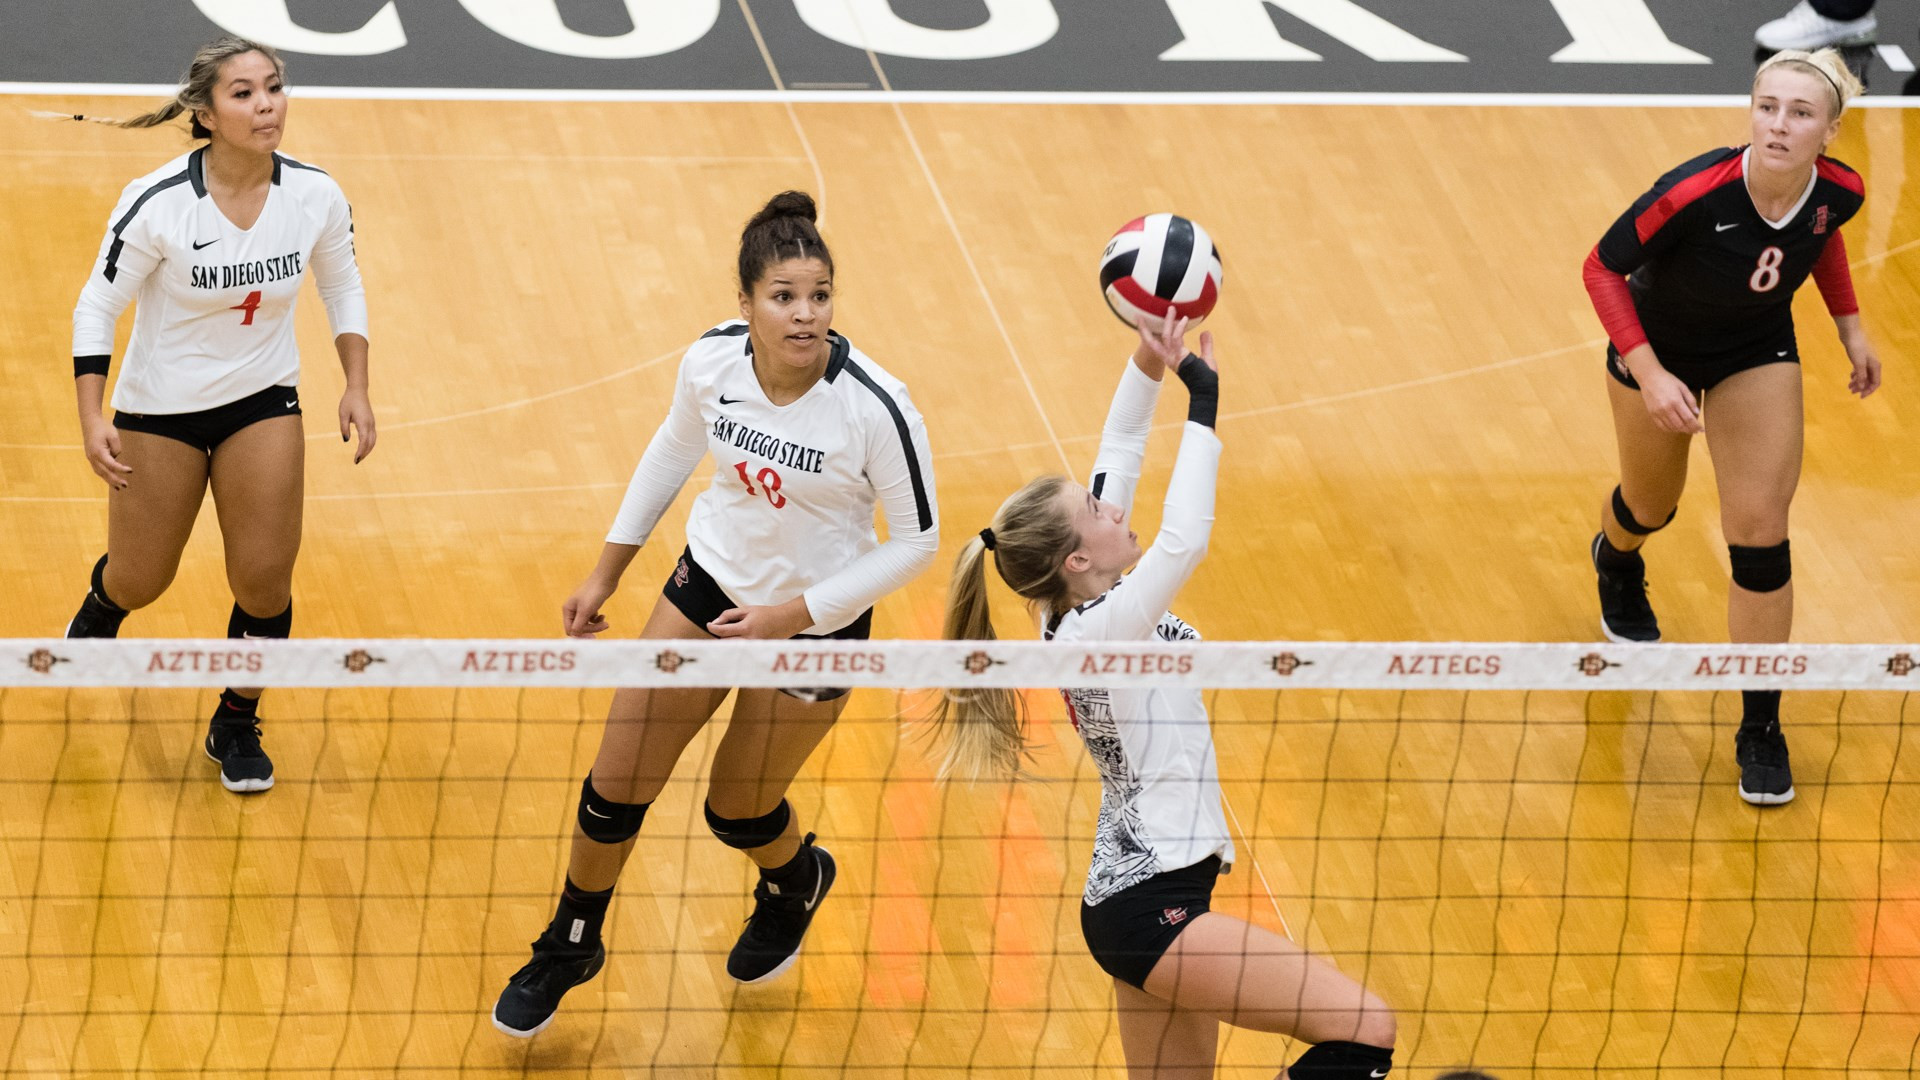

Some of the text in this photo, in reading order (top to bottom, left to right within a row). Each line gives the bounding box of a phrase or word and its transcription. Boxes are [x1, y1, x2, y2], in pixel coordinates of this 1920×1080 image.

[190, 251, 303, 290] SAN DIEGO STATE
[1749, 246, 1784, 292] 8
[229, 290, 262, 326] 4
[712, 415, 825, 474] SAN DIEGO STATE
[145, 650, 264, 674] AZTECS
[461, 650, 577, 674] AZTECS
[770, 651, 886, 675] AZTECS
[1079, 652, 1194, 675] AZTECS
[1386, 654, 1502, 677] AZTECS
[1692, 654, 1808, 677] AZTECS
